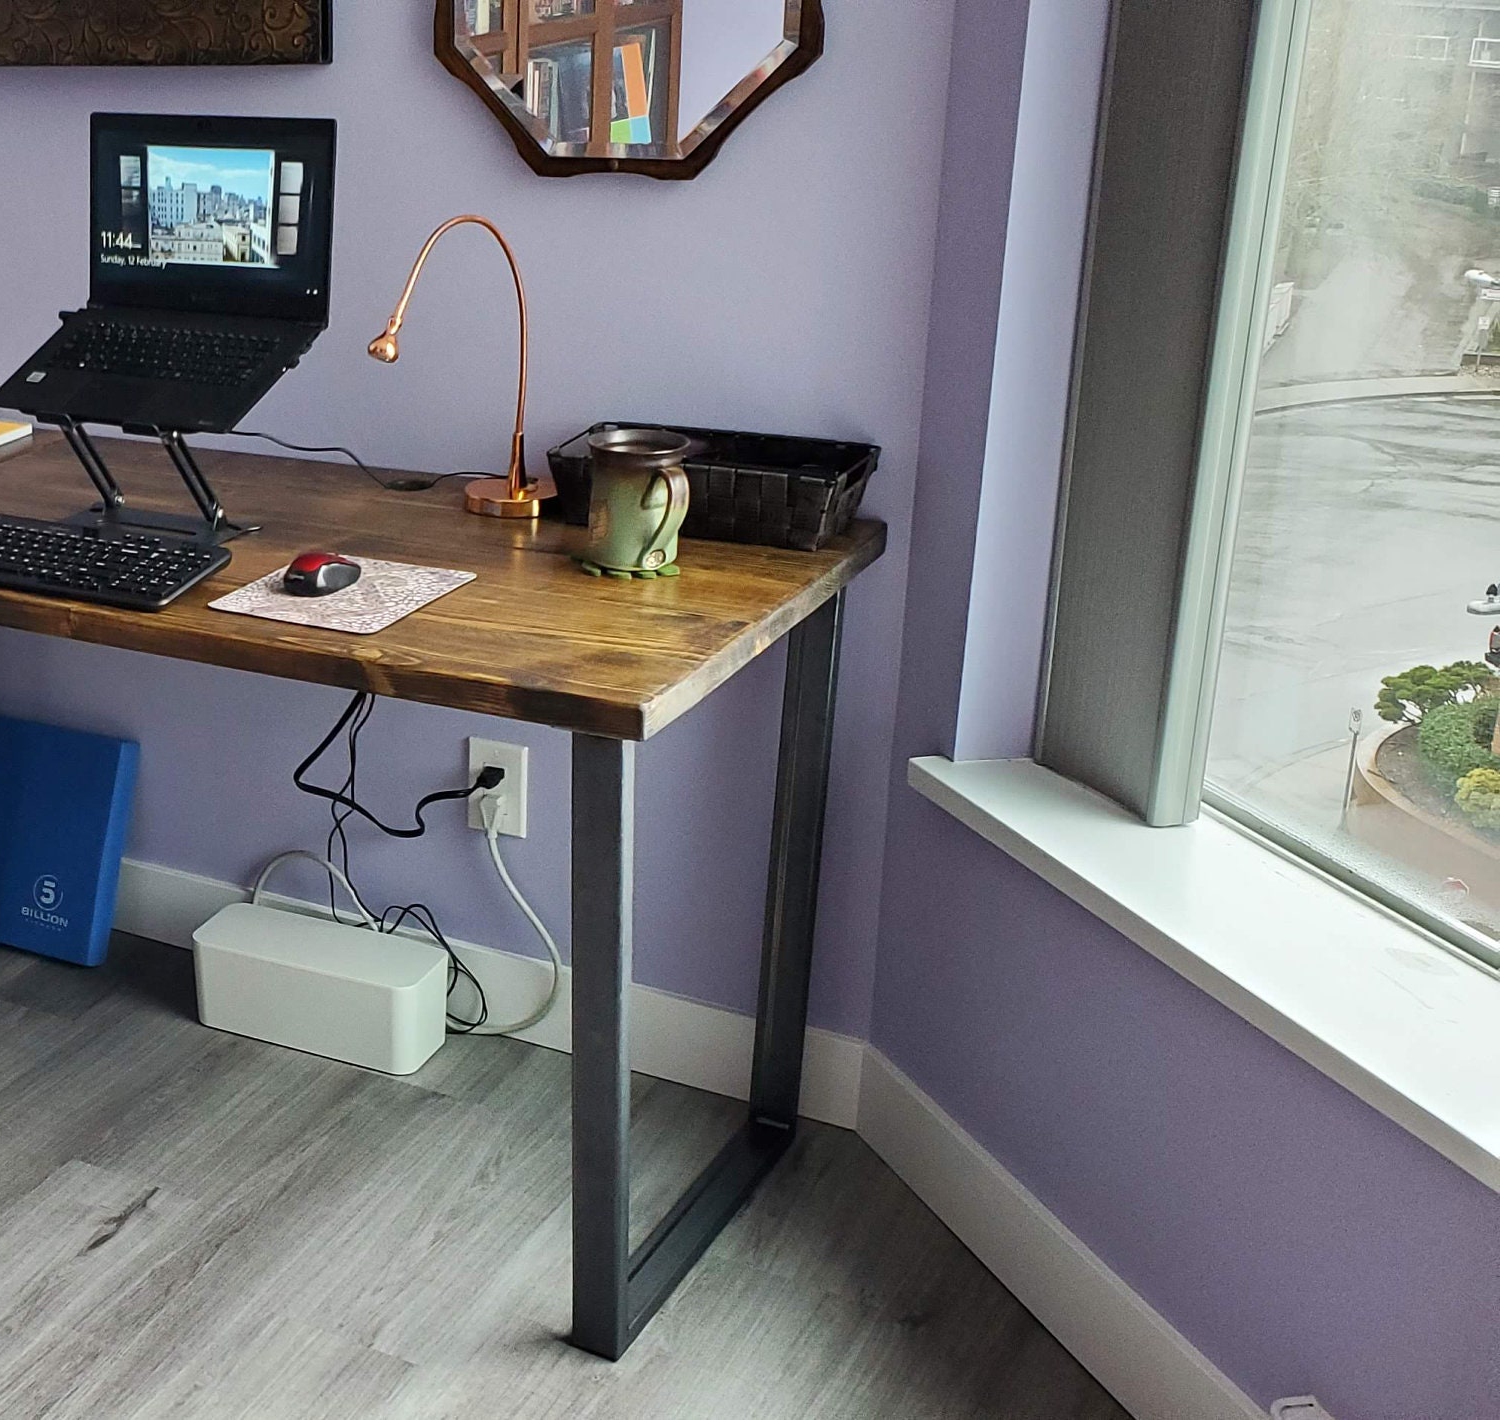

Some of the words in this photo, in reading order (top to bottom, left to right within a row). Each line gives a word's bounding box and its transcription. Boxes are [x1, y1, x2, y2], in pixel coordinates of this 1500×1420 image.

[100, 230, 133, 250] 11:44
[100, 253, 127, 267] Sunday,
[127, 255, 135, 266] 12
